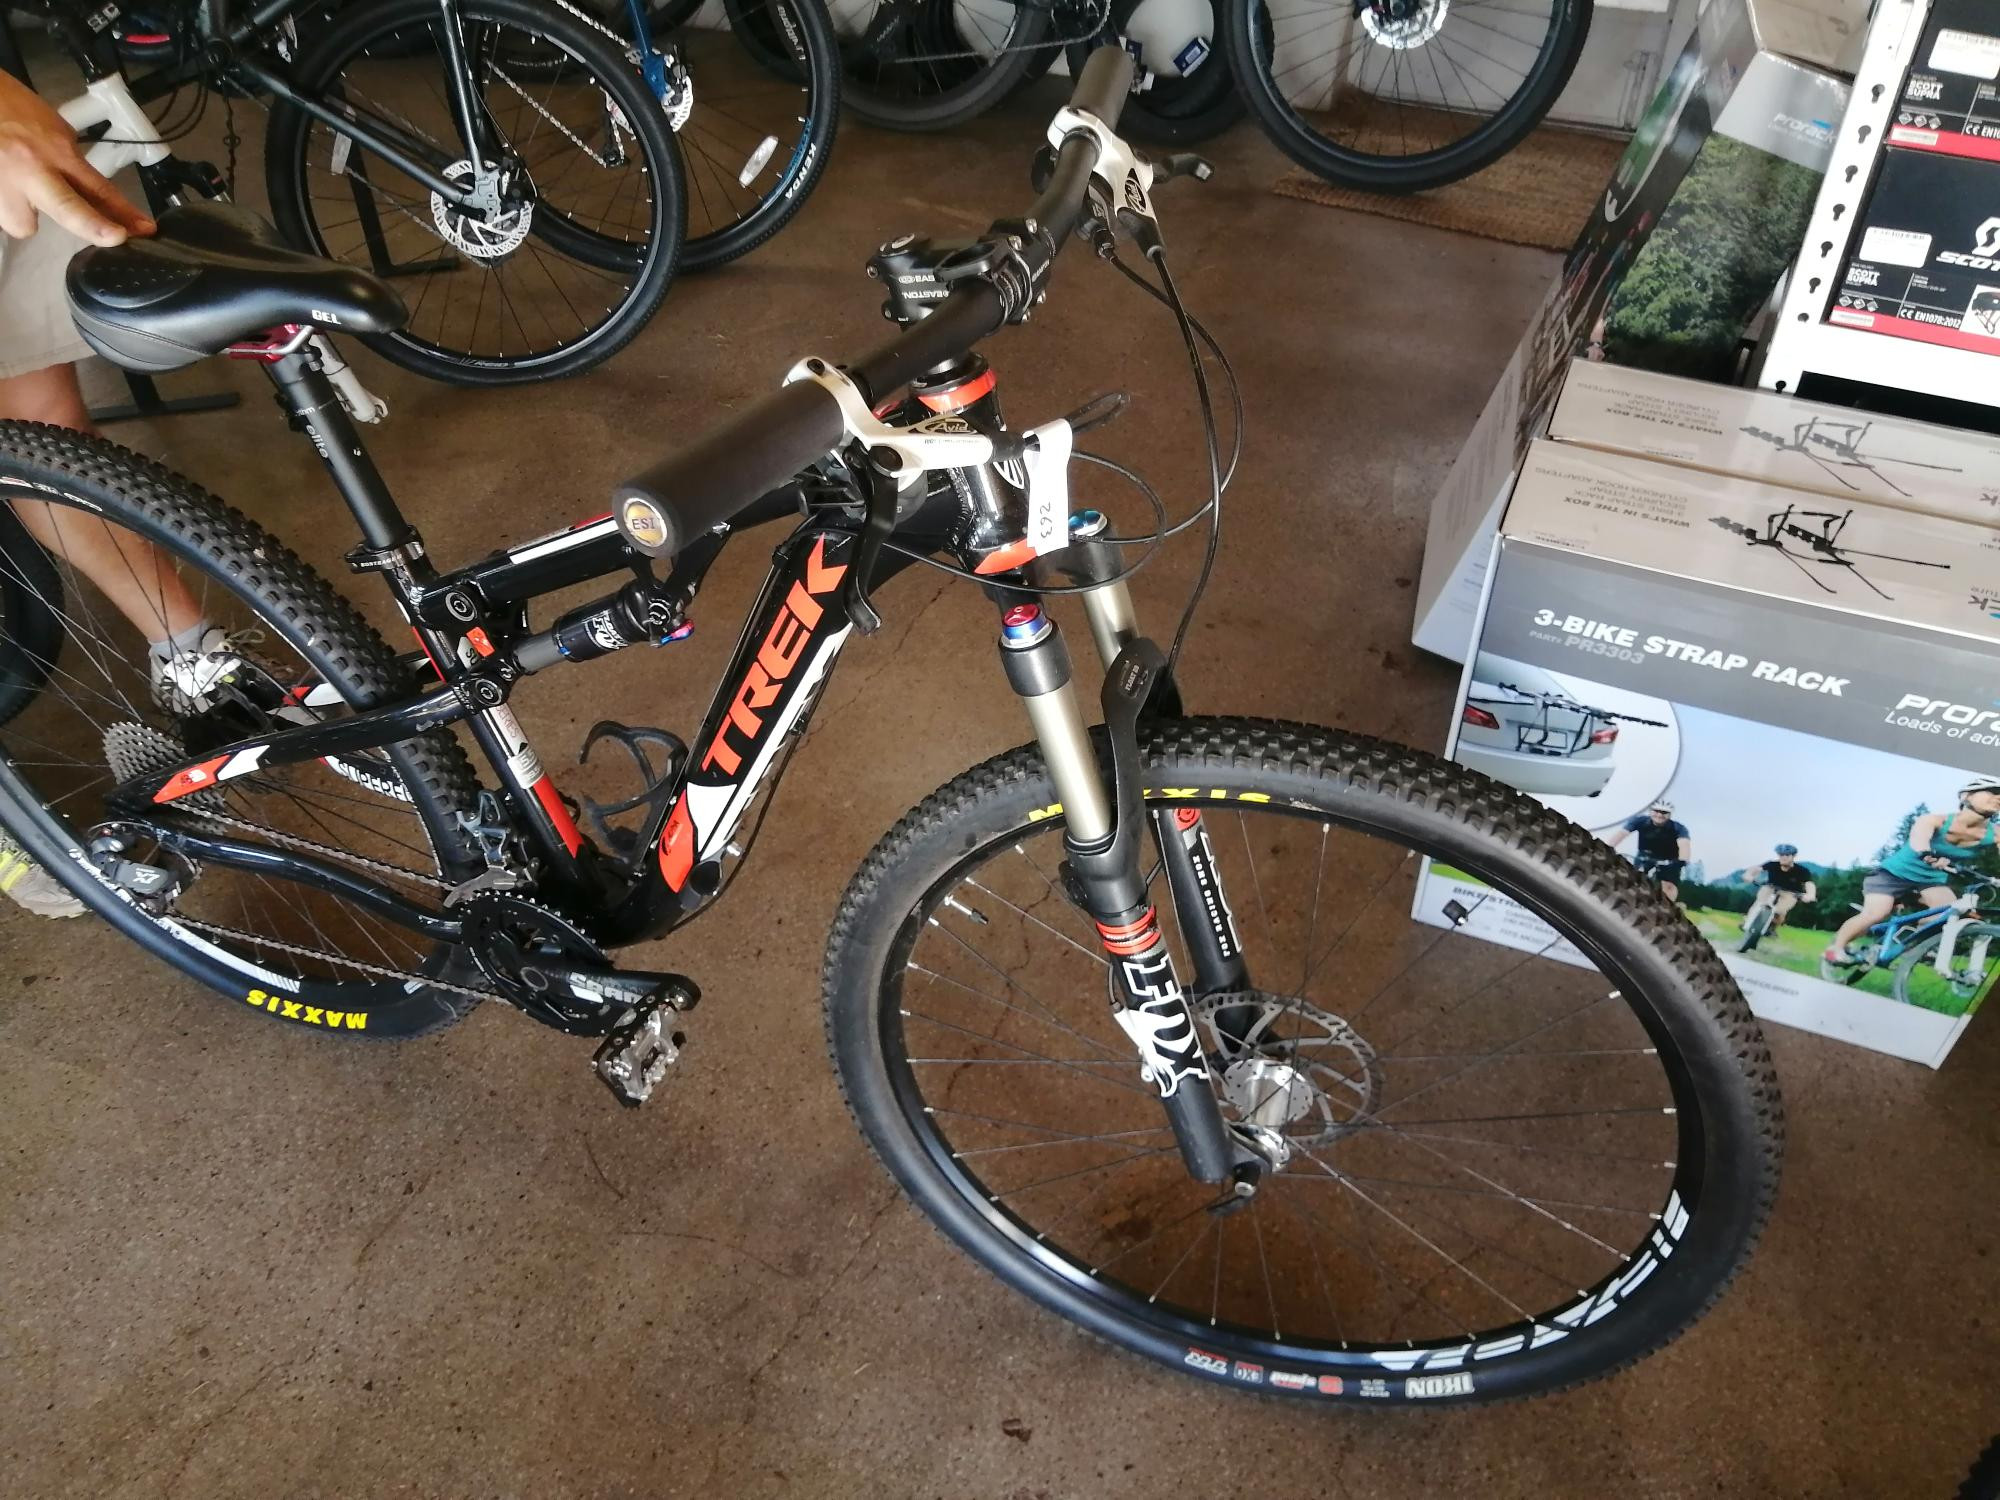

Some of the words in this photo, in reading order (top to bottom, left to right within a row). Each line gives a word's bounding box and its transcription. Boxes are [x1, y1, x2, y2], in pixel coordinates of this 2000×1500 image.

[1906, 87, 1940, 100] SUPRA
[1910, 80, 1944, 92] SCOTT
[786, 143, 817, 199] KENDA
[1846, 275, 1878, 287] SUPRA
[1848, 268, 1880, 279] SCOTT
[903, 291, 945, 300] EASTON
[311, 309, 342, 326] GEL
[1914, 310, 1961, 329] EN1078:2012
[931, 421, 970, 433] Avid
[306, 424, 330, 459] elite
[1563, 496, 1591, 506] BOX
[1594, 503, 1619, 513] THE
[1623, 508, 1638, 517] IN
[1641, 511, 1690, 528] WHAT'S
[632, 518, 656, 530] ESI
[702, 533, 848, 776] TREK
[1534, 609, 1638, 647] 3-BIKE
[1643, 635, 1748, 672] STRAP
[1752, 660, 1851, 697] RACK
[1564, 634, 1645, 665] PR3303
[1885, 711, 1942, 734] Loads
[1947, 727, 1970, 738] of
[1204, 889, 1223, 932] RACING
[1219, 935, 1230, 957] FOX
[246, 988, 368, 1030] MAXXIS
[1122, 952, 1211, 1098] FOX
[1405, 1371, 1475, 1399] IKON
